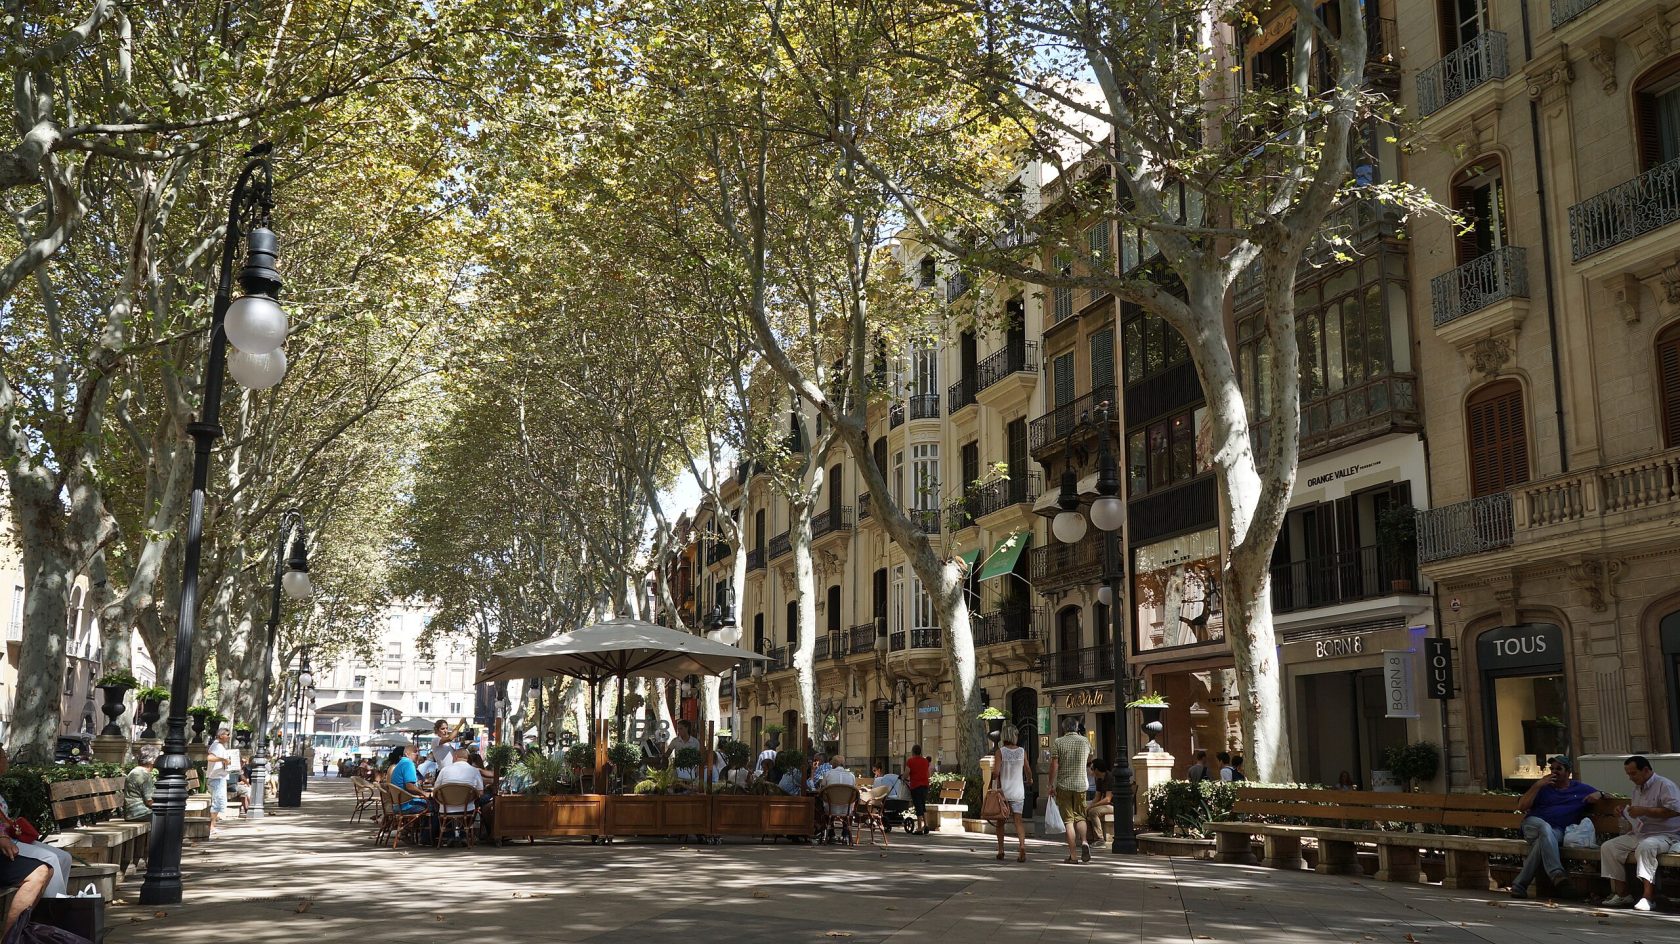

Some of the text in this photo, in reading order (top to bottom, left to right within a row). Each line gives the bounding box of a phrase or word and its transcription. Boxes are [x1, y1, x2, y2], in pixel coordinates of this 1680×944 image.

[1307, 473, 1334, 488] ORANGE
[1334, 465, 1360, 480] VALLEY
[1316, 636, 1363, 658] BORN 8
[1493, 635, 1547, 656] TOUS
[1432, 642, 1447, 695] TOUS
[1389, 656, 1402, 710] BORN 8
